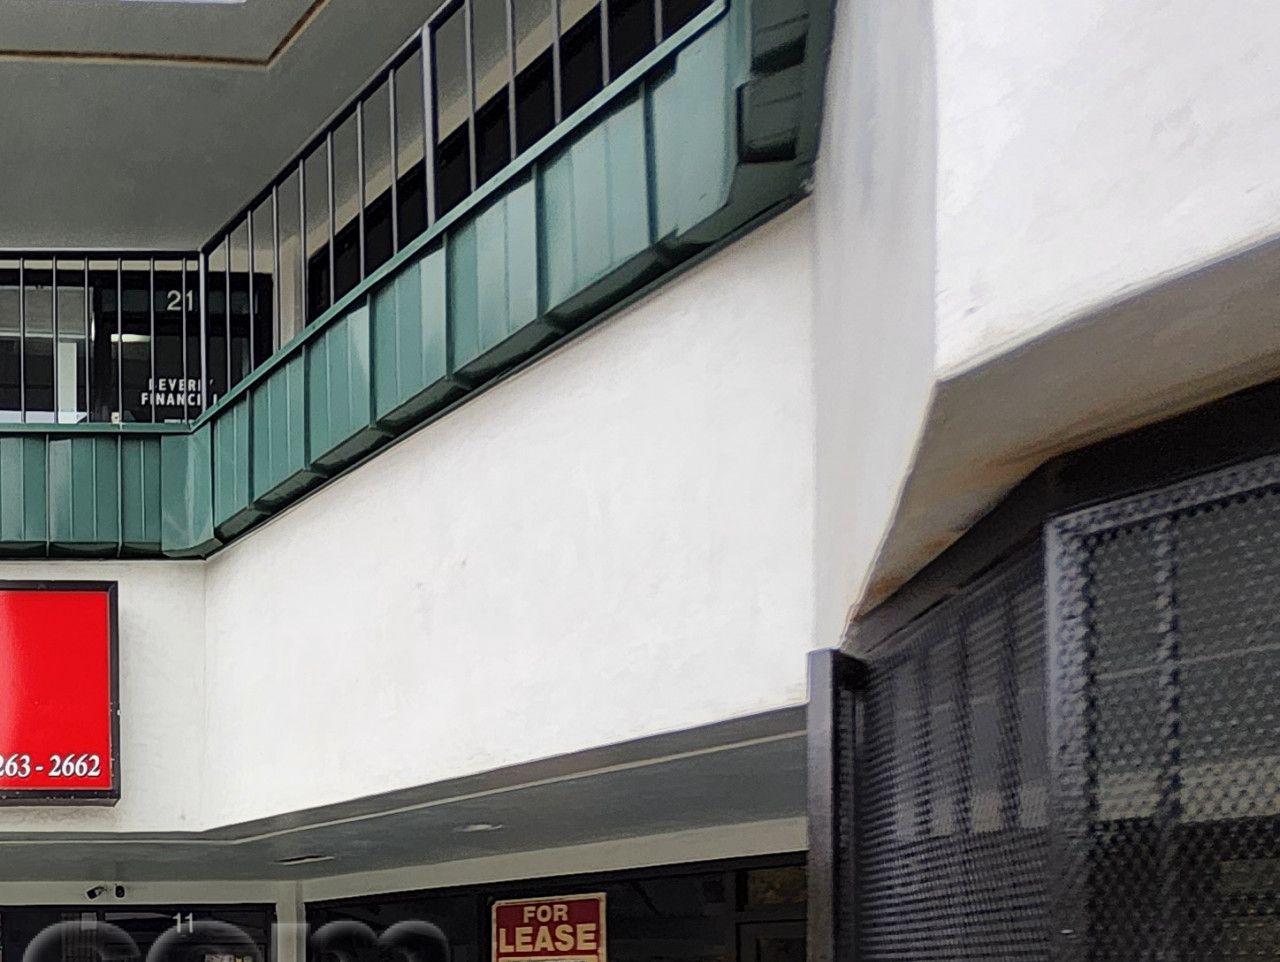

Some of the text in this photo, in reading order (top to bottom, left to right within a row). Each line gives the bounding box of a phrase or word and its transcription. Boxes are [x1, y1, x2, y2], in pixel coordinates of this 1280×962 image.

[166, 289, 194, 312] 21
[48, 753, 101, 777] 2662
[172, 912, 193, 933] 11
[523, 904, 568, 923] FOR
[499, 923, 597, 953] LEASE
